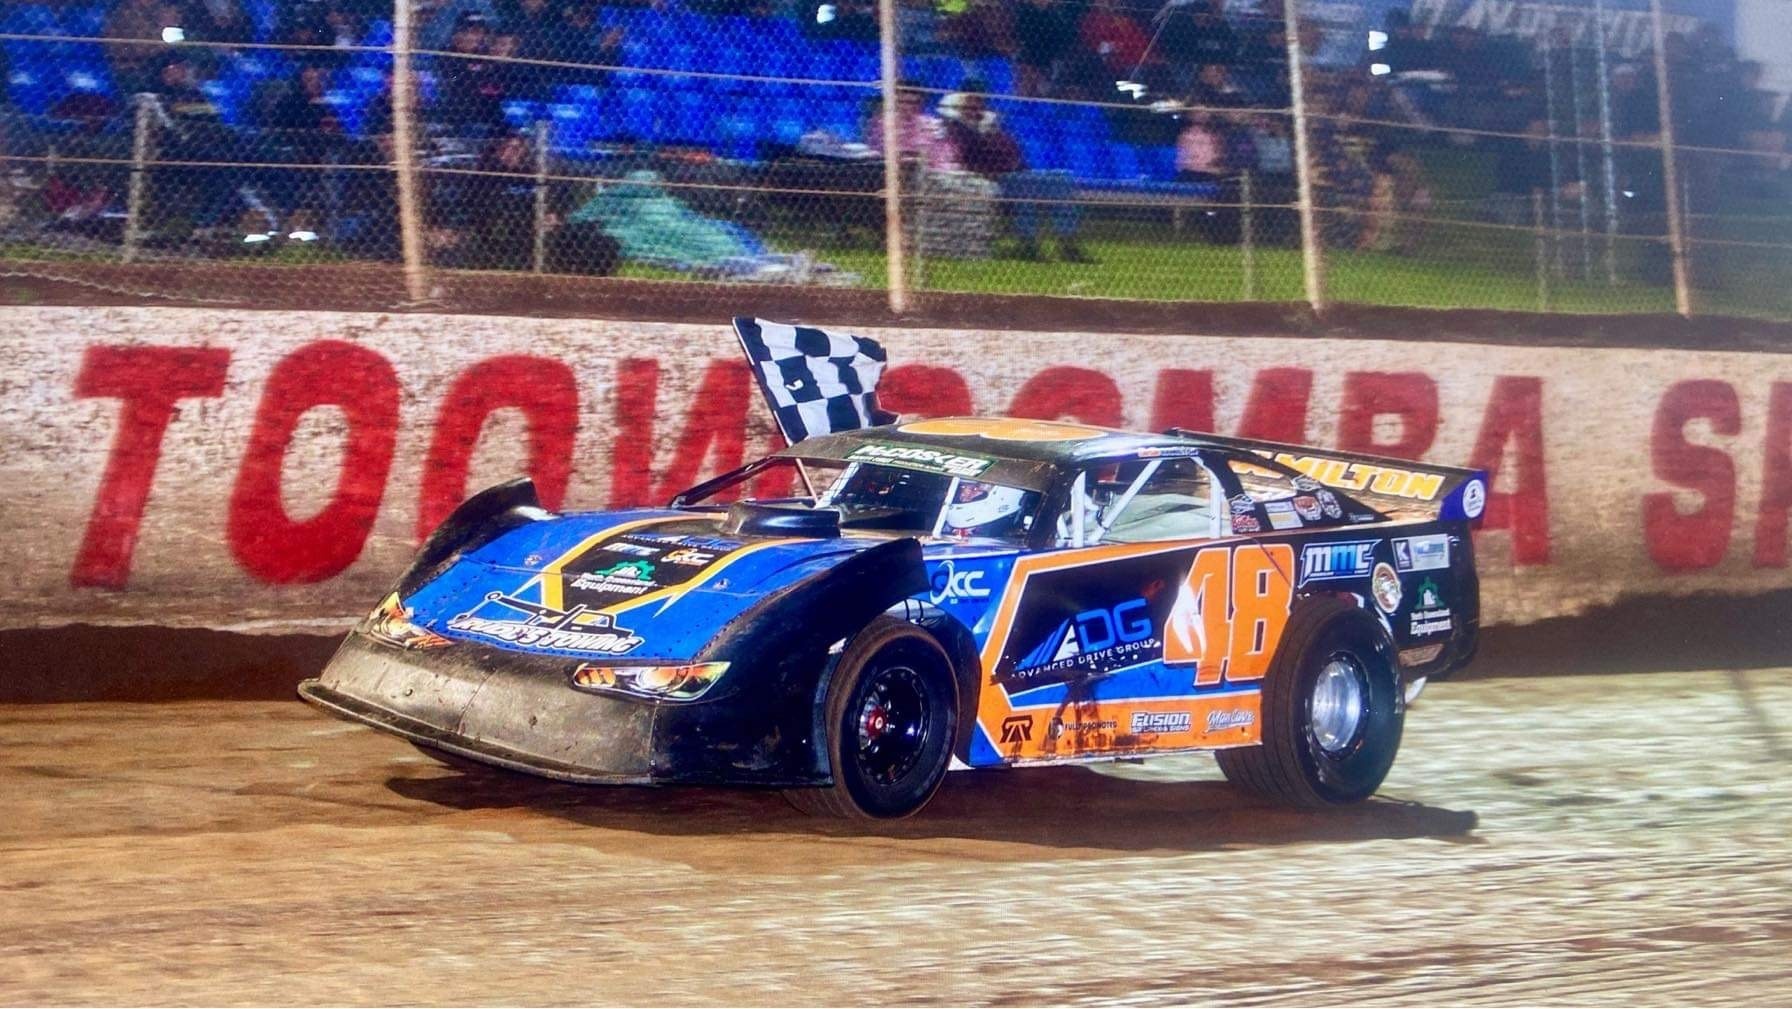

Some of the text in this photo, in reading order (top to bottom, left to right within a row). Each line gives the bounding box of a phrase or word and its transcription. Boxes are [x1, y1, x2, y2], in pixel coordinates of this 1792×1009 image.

[1228, 450, 1446, 501] MILTON
[570, 578, 649, 595] Equipment
[1053, 598, 1152, 662] ADG
[1163, 543, 1295, 687] 48
[1012, 638, 1156, 679] DVANCED DRIVE GROUP
